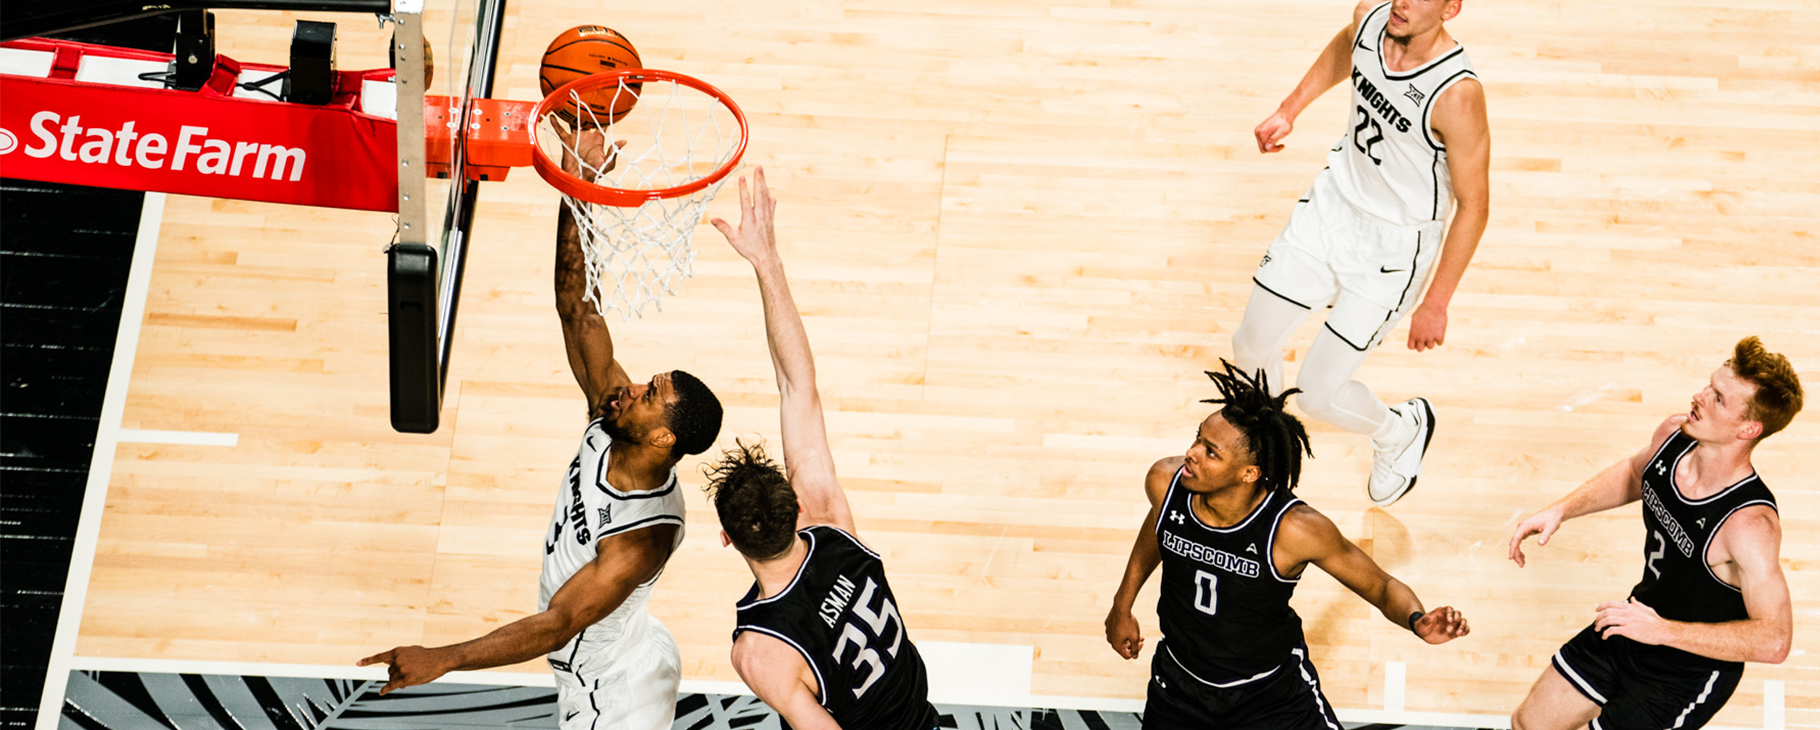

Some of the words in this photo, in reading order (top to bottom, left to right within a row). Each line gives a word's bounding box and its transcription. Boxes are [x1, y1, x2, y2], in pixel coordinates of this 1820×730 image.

[1351, 64, 1412, 133] KNIGHTS
[1353, 104, 1384, 166] 22
[1642, 480, 1695, 558] LIPSCOMB
[1162, 529, 1260, 578] LIPSCOMB
[1647, 529, 1666, 580] 2
[818, 574, 856, 629] ASMAN
[1194, 569, 1218, 615] 0
[831, 576, 903, 700] 35
